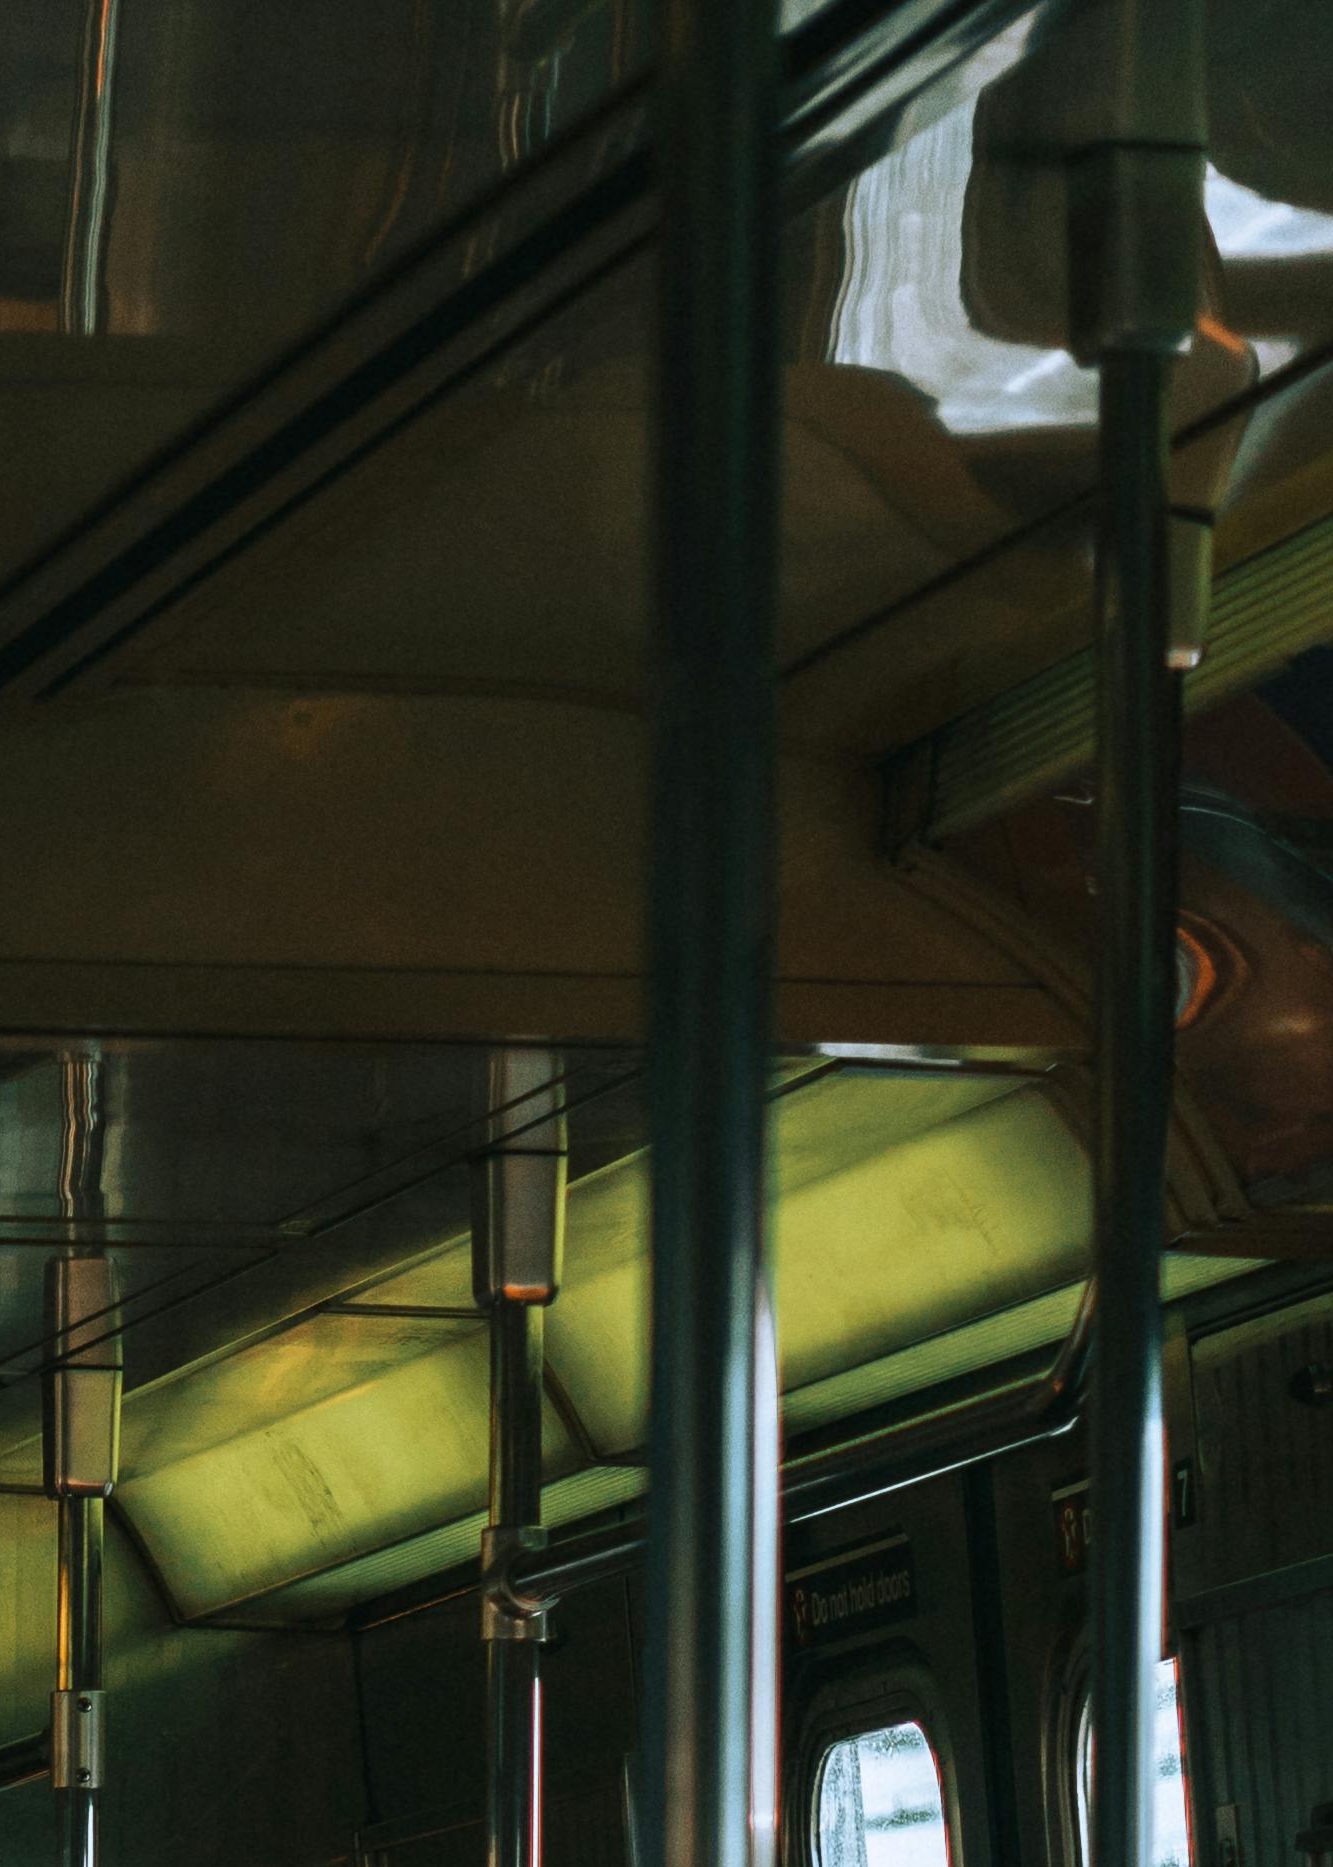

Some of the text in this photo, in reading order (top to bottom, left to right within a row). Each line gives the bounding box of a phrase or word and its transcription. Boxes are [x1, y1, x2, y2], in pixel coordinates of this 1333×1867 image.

[1177, 1469, 1188, 1517] 7
[811, 1570, 911, 1625] Do not hold doors
